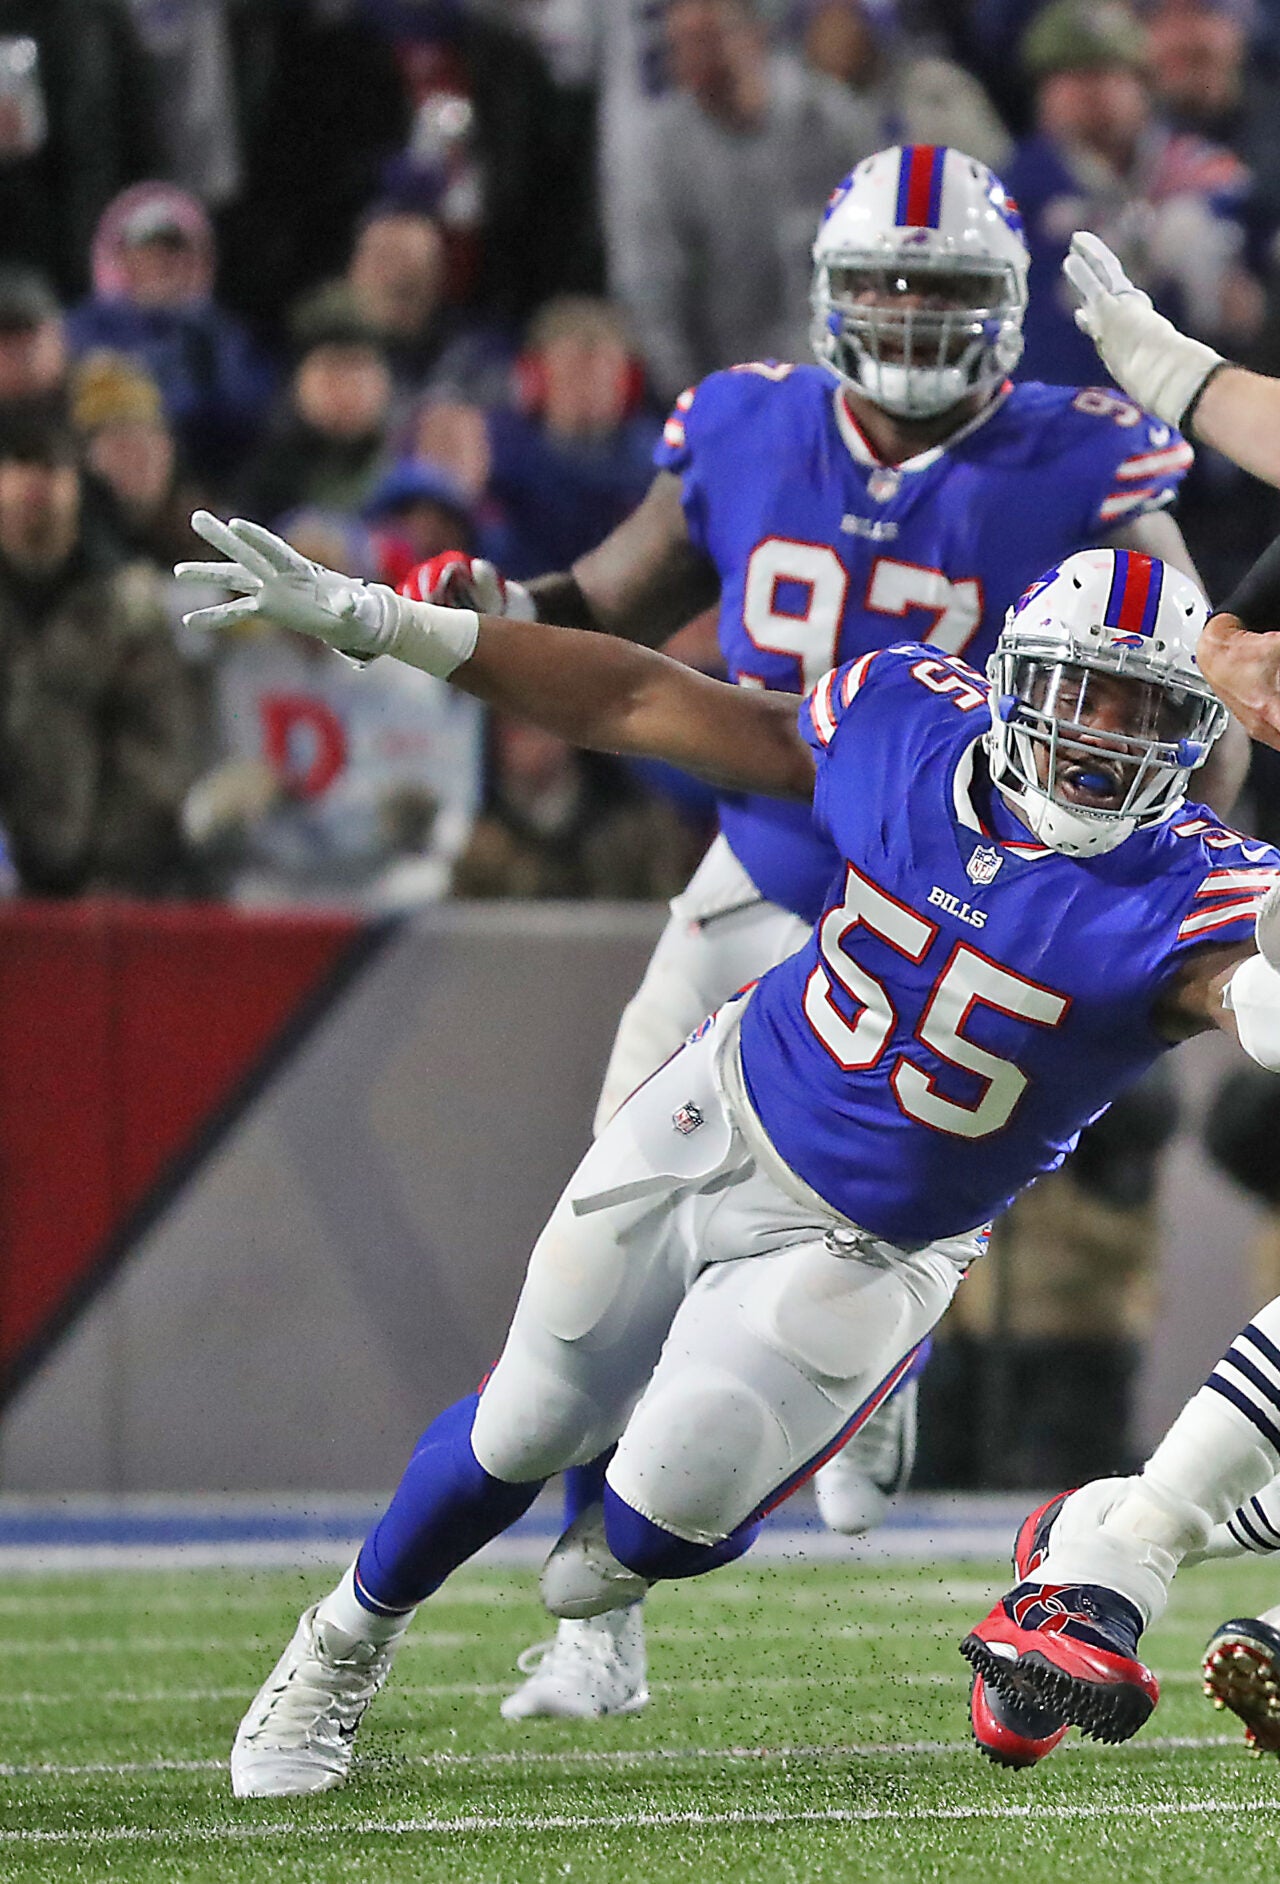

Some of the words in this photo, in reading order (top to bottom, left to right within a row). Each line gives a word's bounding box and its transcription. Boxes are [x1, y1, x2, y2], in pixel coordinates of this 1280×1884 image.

[739, 533, 985, 697] 97
[926, 885, 989, 929] BILLS
[803, 859, 1070, 1142] 55
